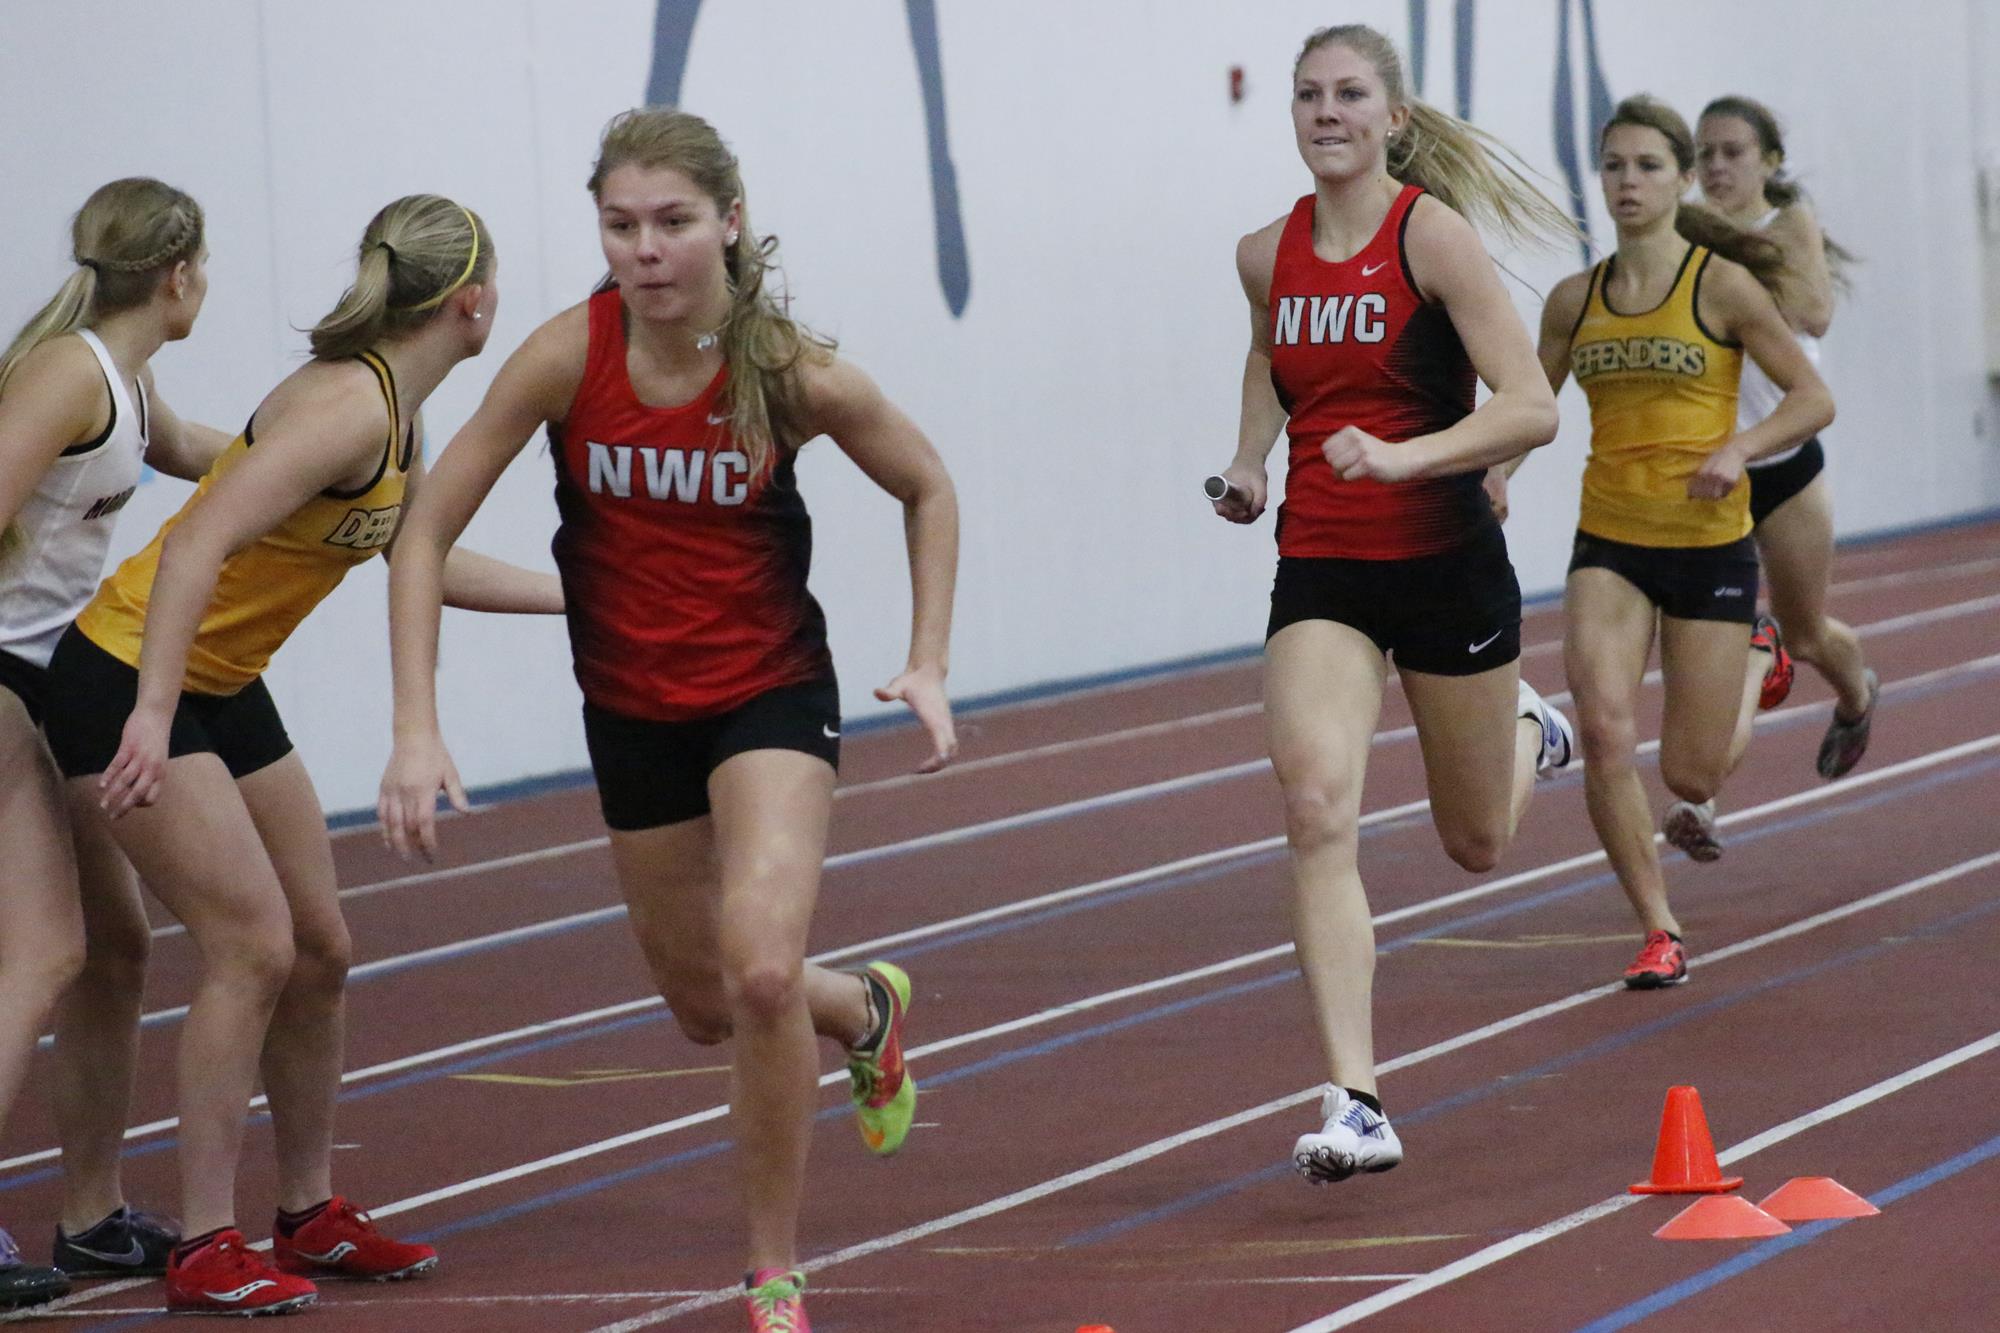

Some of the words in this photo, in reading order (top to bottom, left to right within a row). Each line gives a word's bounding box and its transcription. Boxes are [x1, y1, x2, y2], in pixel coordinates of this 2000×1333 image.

[1274, 293, 1387, 346] NWC
[1572, 337, 1706, 379] EFENDERS
[586, 441, 748, 506] NWC
